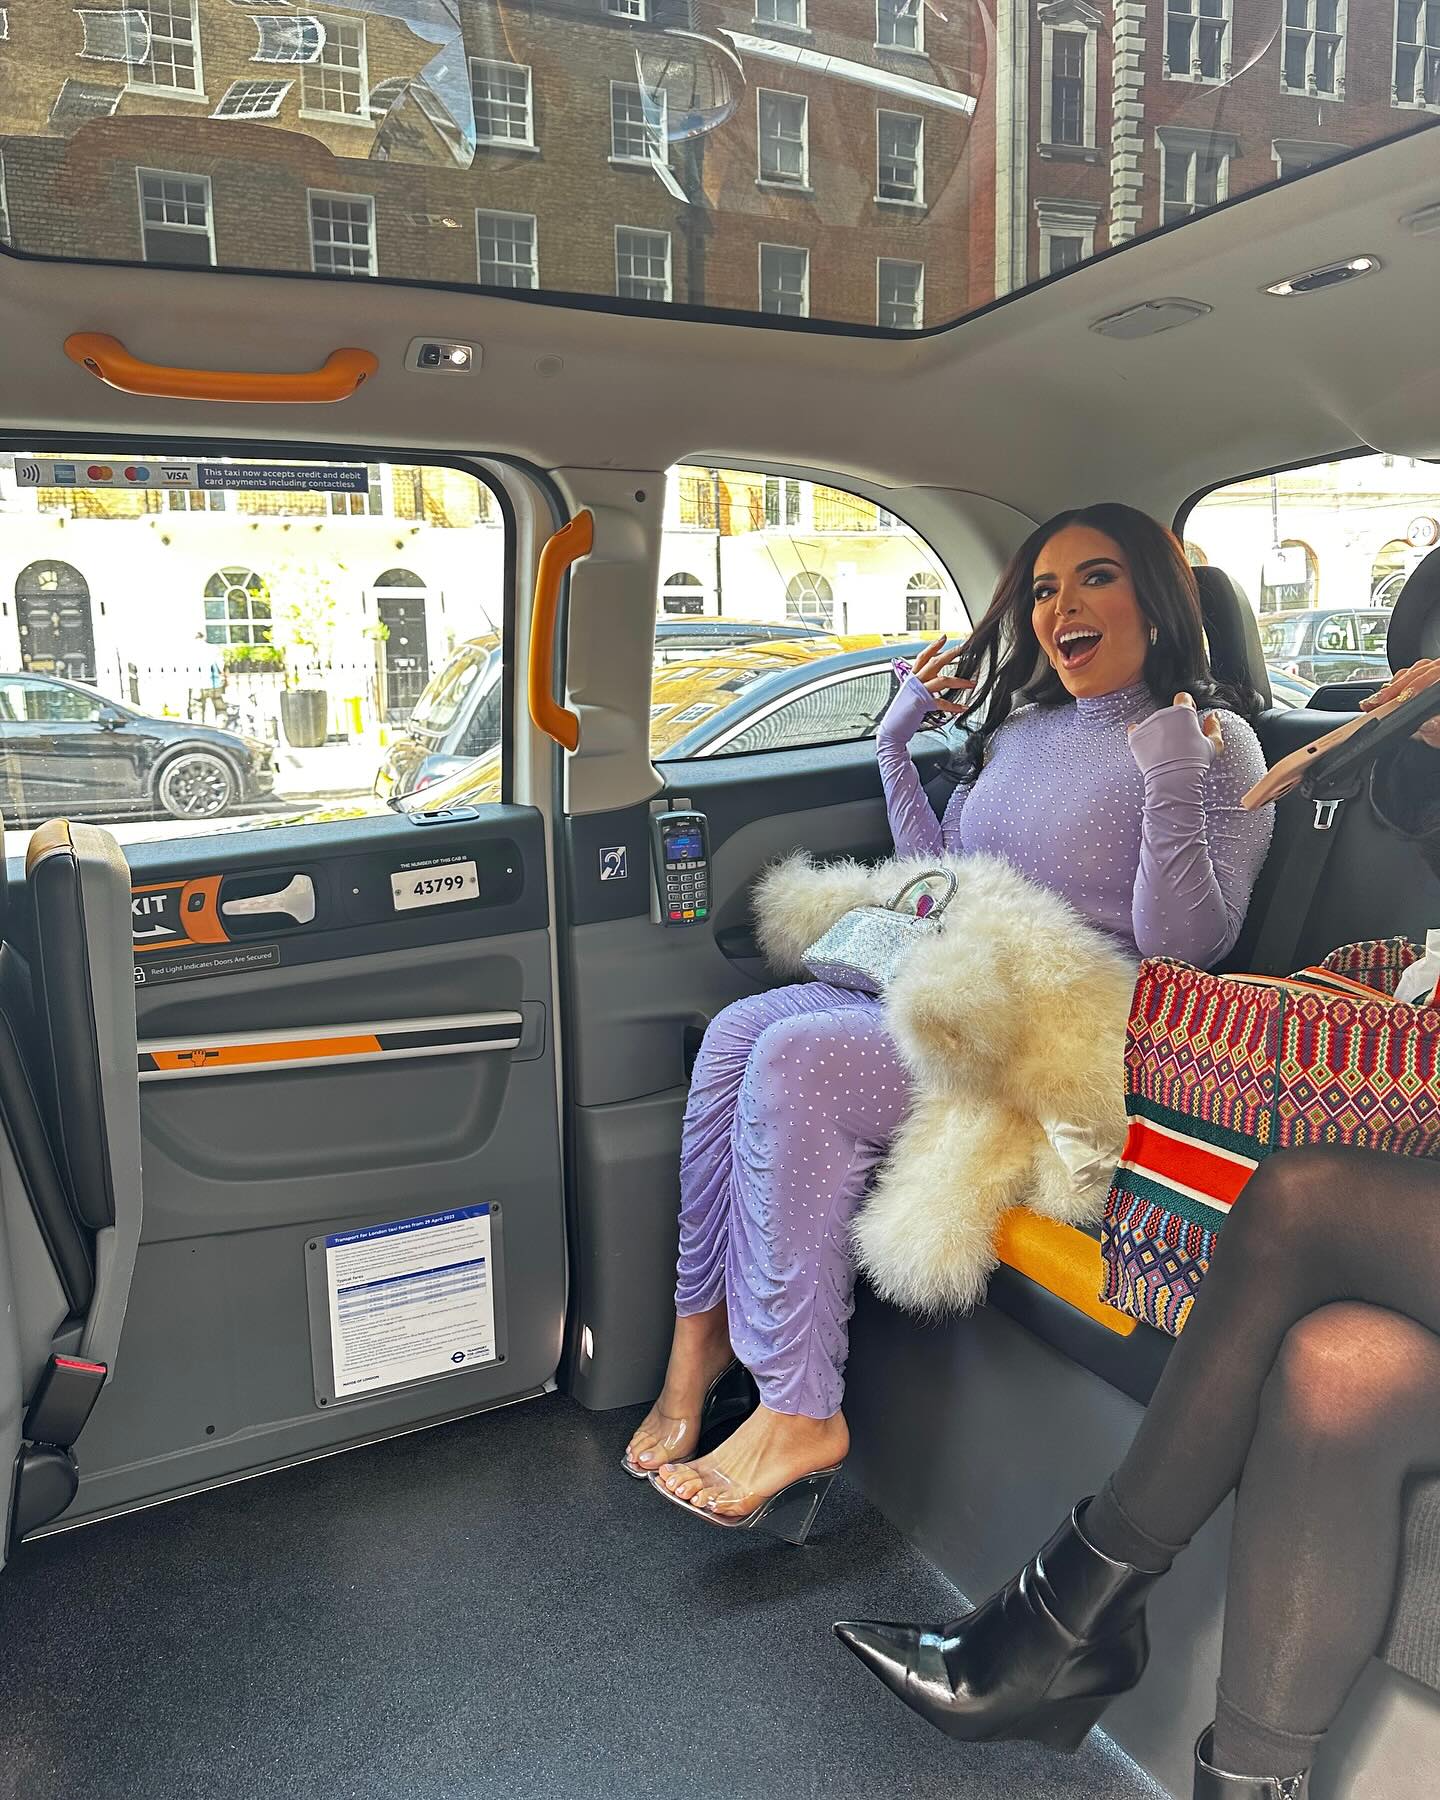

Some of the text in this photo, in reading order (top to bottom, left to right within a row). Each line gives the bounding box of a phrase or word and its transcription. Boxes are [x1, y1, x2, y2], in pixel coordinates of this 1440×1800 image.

[166, 471, 189, 480] VISA
[204, 468, 222, 477] This
[224, 469, 241, 477] taxi
[262, 470, 296, 479] accepts
[297, 471, 321, 479] credit
[323, 471, 338, 479] and
[339, 472, 361, 480] debit
[204, 478, 356, 489] card payments including contactless
[1411, 525, 1432, 539] 20
[413, 875, 464, 895] 43799
[151, 952, 272, 975] Red Light Indicates Doors Are Secured
[335, 1233, 359, 1243] Transport
[368, 1228, 388, 1237] London
